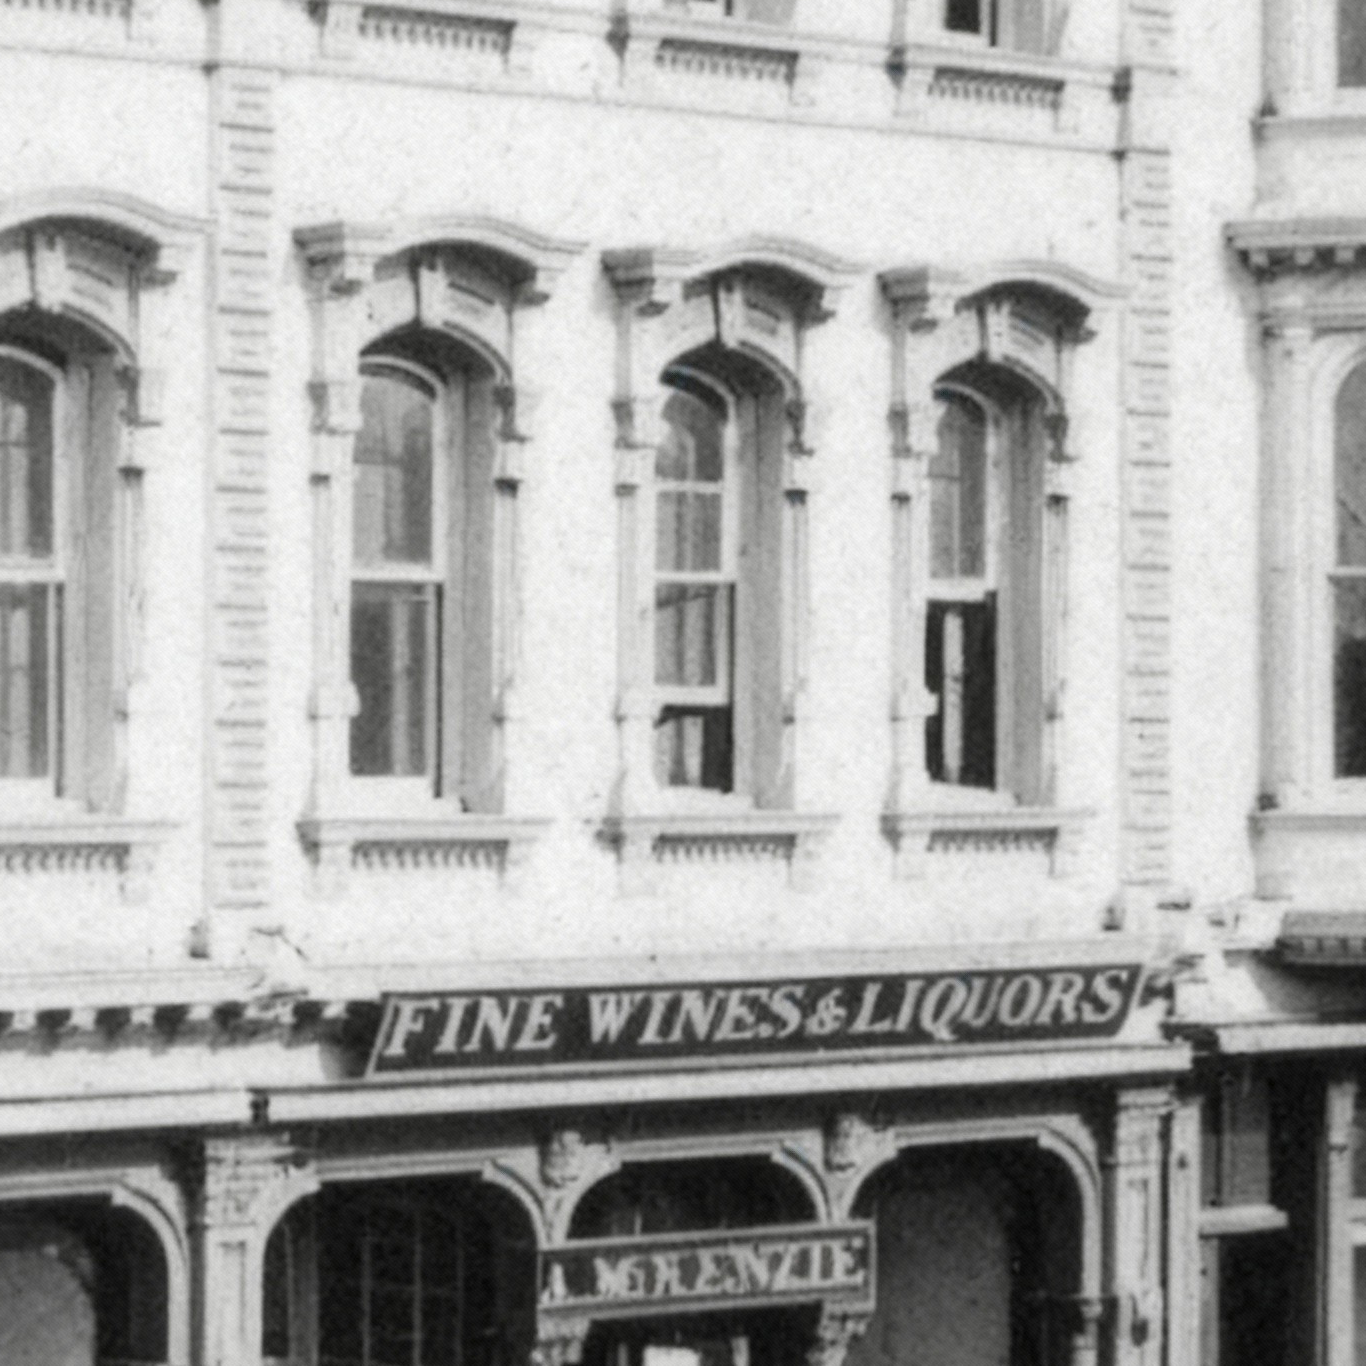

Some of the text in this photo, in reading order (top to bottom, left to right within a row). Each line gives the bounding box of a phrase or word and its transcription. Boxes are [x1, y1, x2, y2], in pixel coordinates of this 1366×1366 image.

[384, 968, 1130, 1056] FINE WINES & LIQUORS
